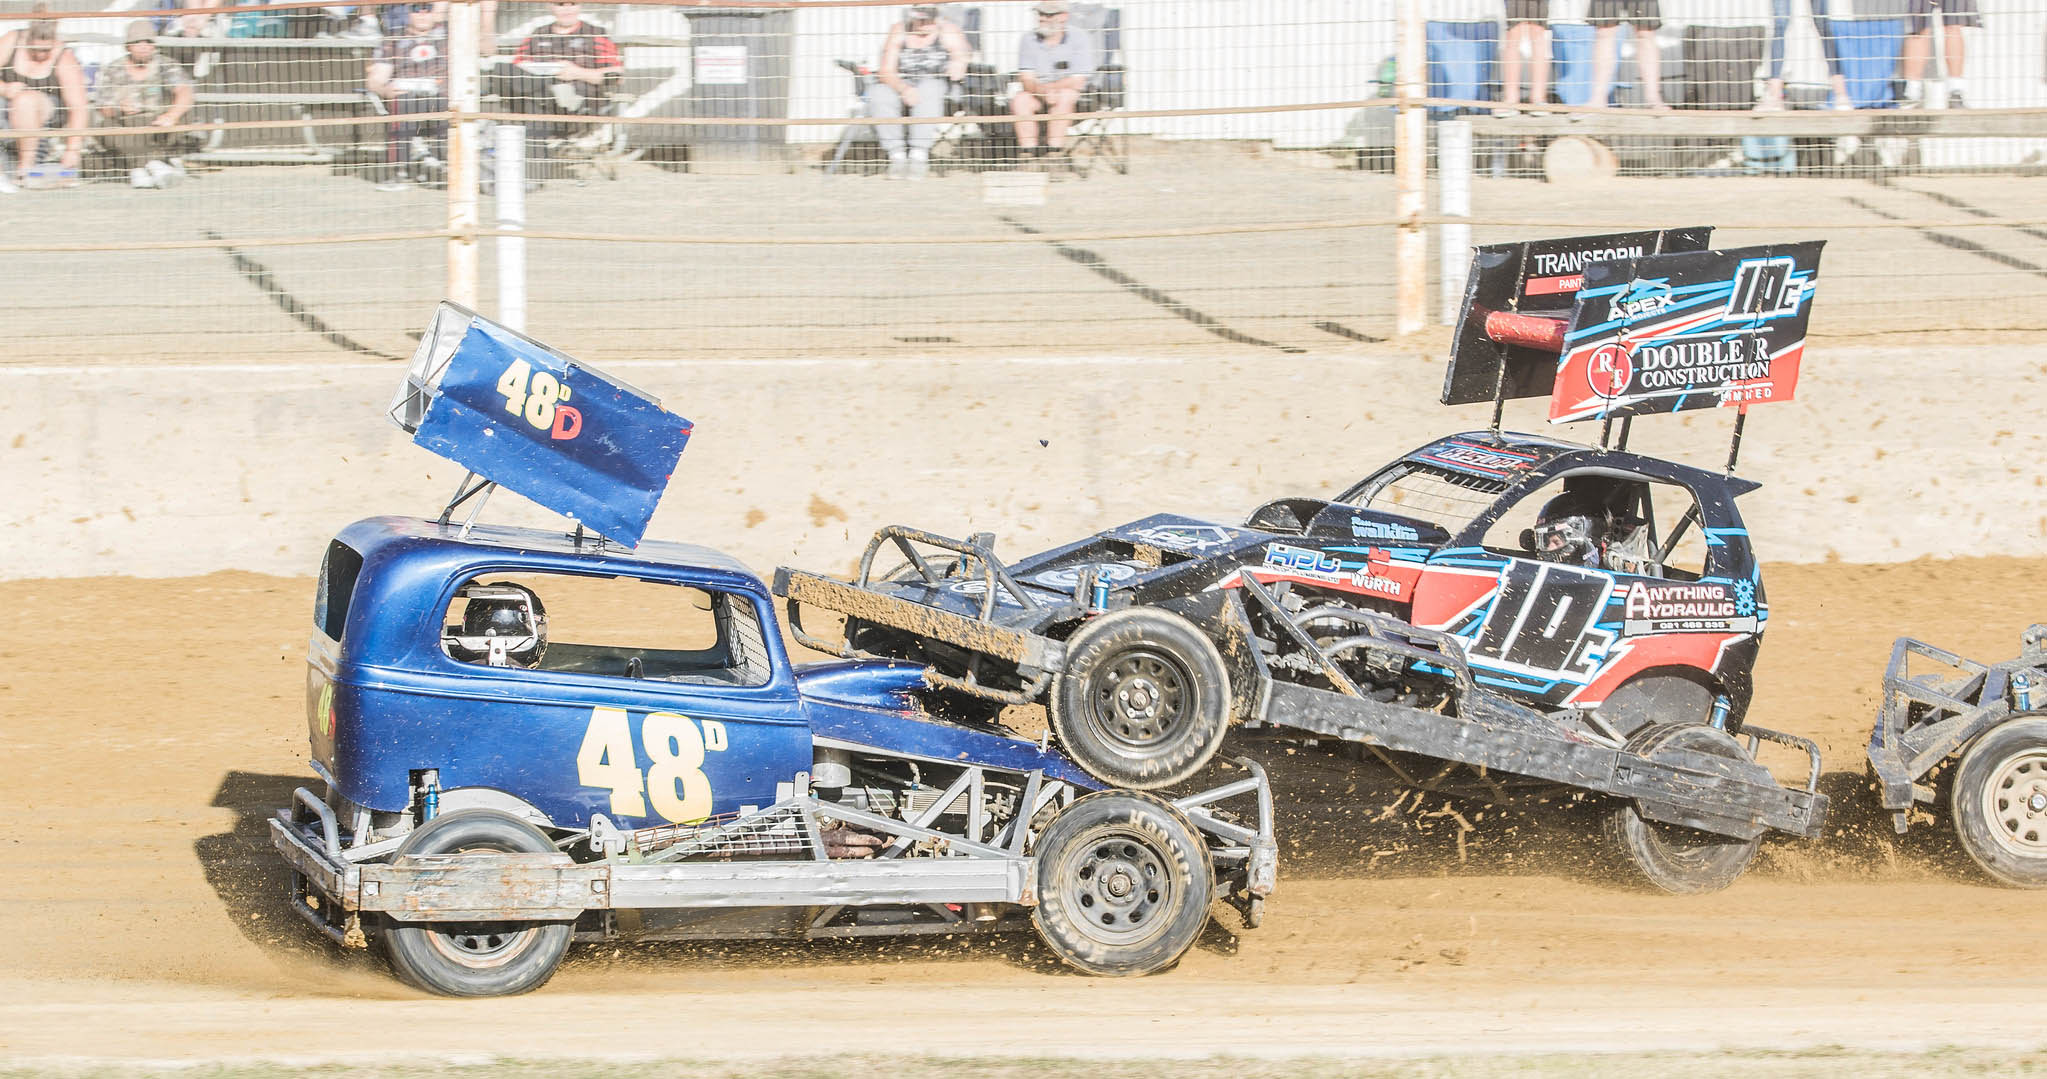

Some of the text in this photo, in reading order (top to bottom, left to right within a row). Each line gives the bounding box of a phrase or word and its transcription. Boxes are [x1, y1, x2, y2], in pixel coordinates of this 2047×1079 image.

[1533, 246, 1643, 275] TRANSFORM
[1607, 296, 1675, 321] APEX
[1640, 336, 1769, 371] DOUBLE R
[1640, 360, 1771, 389] CONSTRUCTION
[1720, 387, 1772, 403] LIMITED
[551, 404, 583, 440] D
[1626, 594, 1735, 619] HYDRAULIC
